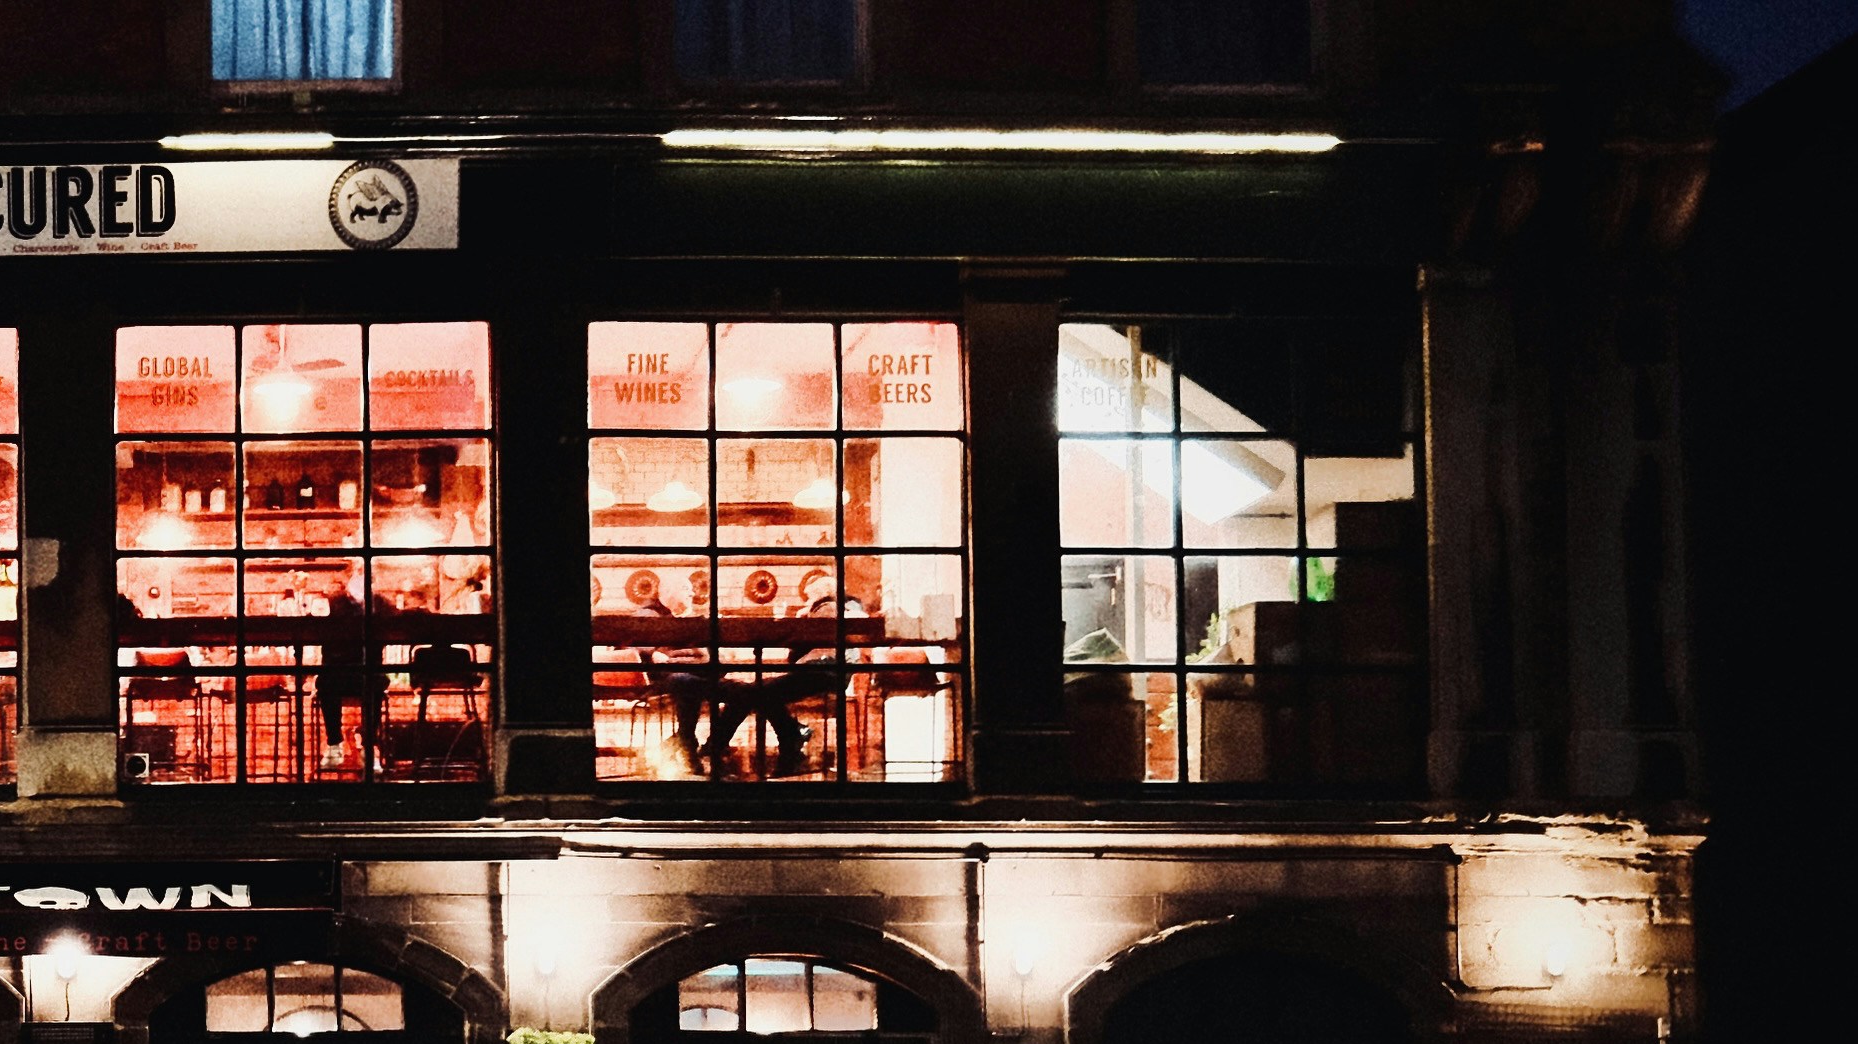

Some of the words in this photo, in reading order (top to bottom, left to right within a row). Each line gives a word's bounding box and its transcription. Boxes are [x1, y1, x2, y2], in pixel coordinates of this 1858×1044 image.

[97, 242, 125, 251] Wine
[173, 242, 198, 250] Beer
[138, 356, 213, 378] GLOBAL
[627, 353, 670, 375] FINE
[868, 354, 933, 376] CRAFT
[1072, 357, 1158, 379] ARTISN
[384, 369, 474, 388] COCKTAILS
[151, 386, 199, 406] GINS
[614, 382, 682, 405] WINES
[868, 383, 933, 404] BEERS
[1081, 385, 1150, 406] COFFE
[187, 932, 258, 952] Beer
